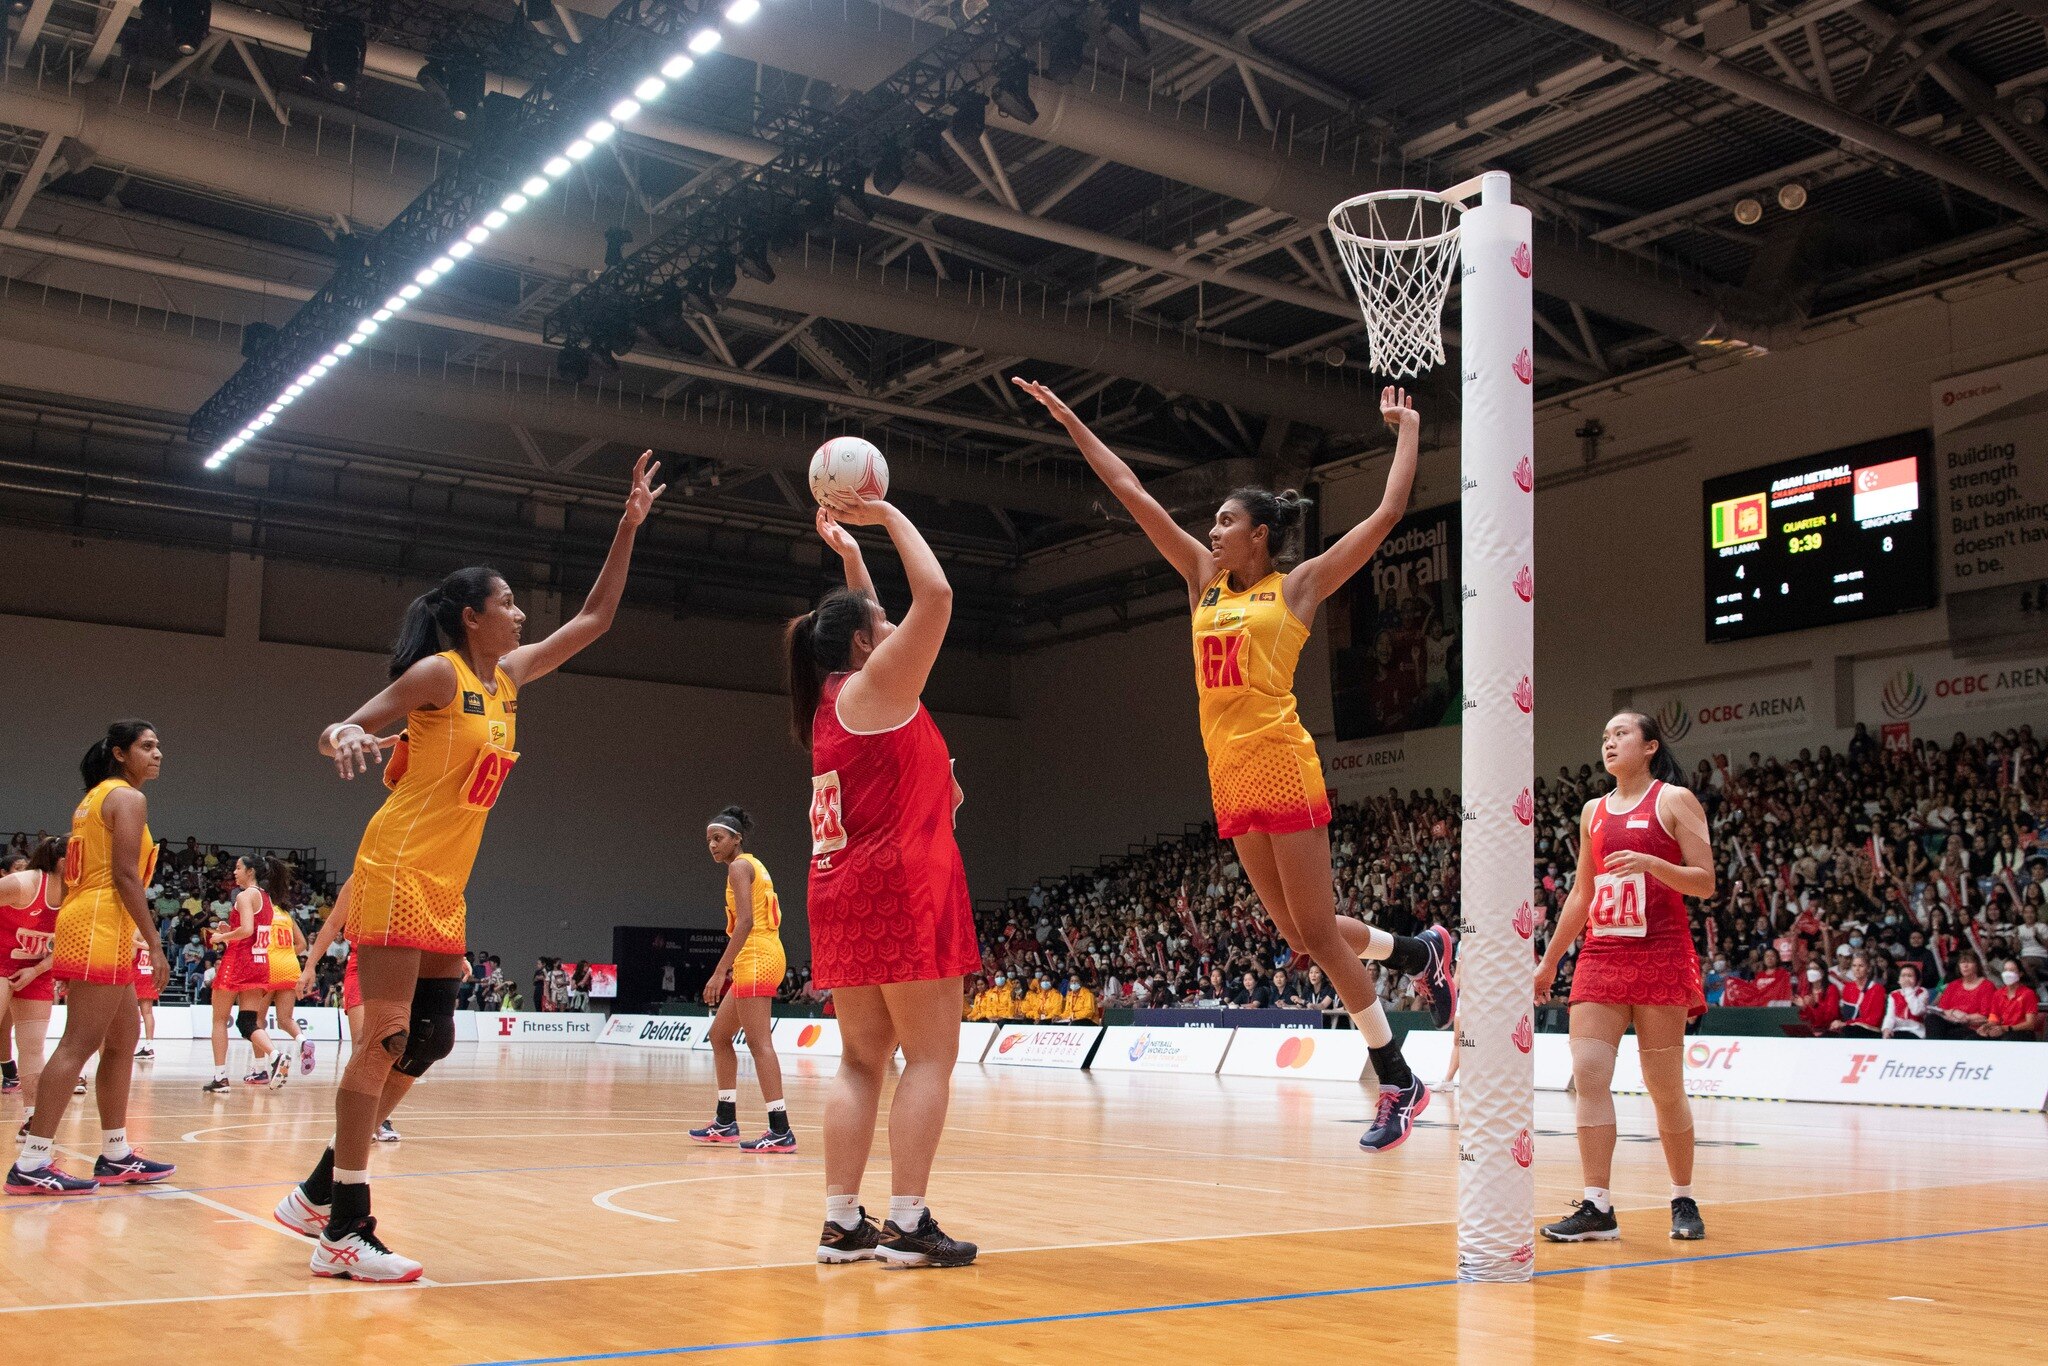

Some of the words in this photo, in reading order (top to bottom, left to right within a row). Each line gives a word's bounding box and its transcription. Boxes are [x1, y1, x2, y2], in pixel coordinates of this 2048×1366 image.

[1947, 443, 2015, 469] Building
[1949, 462, 2018, 491] strength
[1950, 496, 1963, 513] is
[1967, 484, 2022, 508] tough.
[1783, 516, 1826, 533] QUARTER
[1830, 513, 1837, 522] 1
[1861, 510, 1912, 529] SINGAPORE
[1952, 515, 1979, 534] But
[1374, 521, 1447, 560] ootball
[1734, 541, 1760, 555] LANKA
[1789, 533, 1822, 553] 9:39
[1883, 536, 1893, 552] 8
[1954, 529, 2015, 555] doesn't
[2020, 526, 2048, 544] hav
[1372, 560, 1412, 598] for
[1416, 544, 1448, 585] all
[1735, 564, 1745, 579] 4
[1955, 562, 1972, 577] to
[1977, 557, 2004, 574] be.
[1753, 587, 1761, 599] 4
[1781, 582, 1789, 594] 8
[1203, 635, 1244, 688] GK
[1935, 674, 1989, 699] OCBC
[1997, 667, 2048, 690] AREN
[1699, 701, 1743, 724] OCBC
[1748, 696, 1806, 718] ARENA
[1332, 754, 1363, 770] OCBC
[1366, 749, 1405, 766] ARENA
[1593, 881, 1643, 927] GA
[1031, 1032, 1082, 1047] NETBALL
